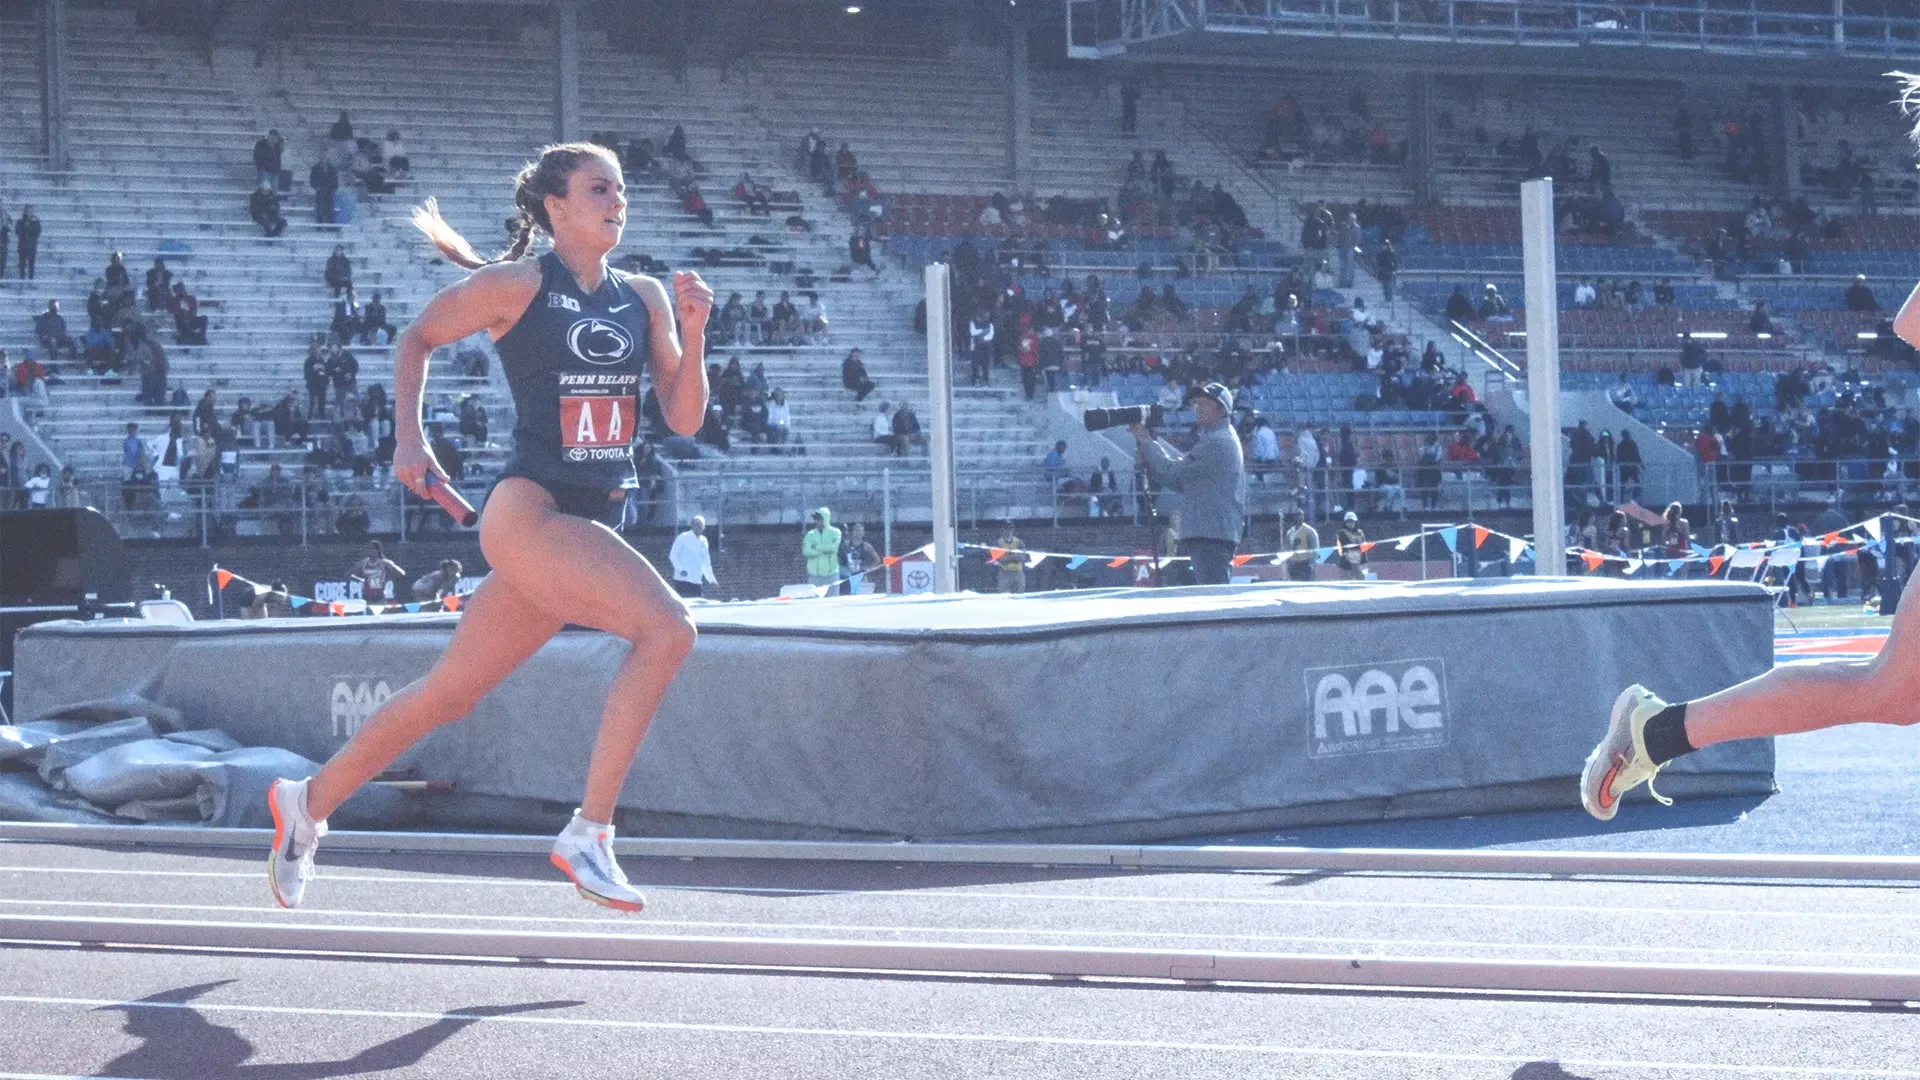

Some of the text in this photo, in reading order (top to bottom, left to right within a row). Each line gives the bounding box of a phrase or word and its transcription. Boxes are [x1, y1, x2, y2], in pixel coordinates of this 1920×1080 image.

[559, 375, 638, 385] PENN RELAYS
[577, 401, 622, 442] A A
[590, 447, 625, 460] TOYOTA
[315, 581, 348, 602] CORE
